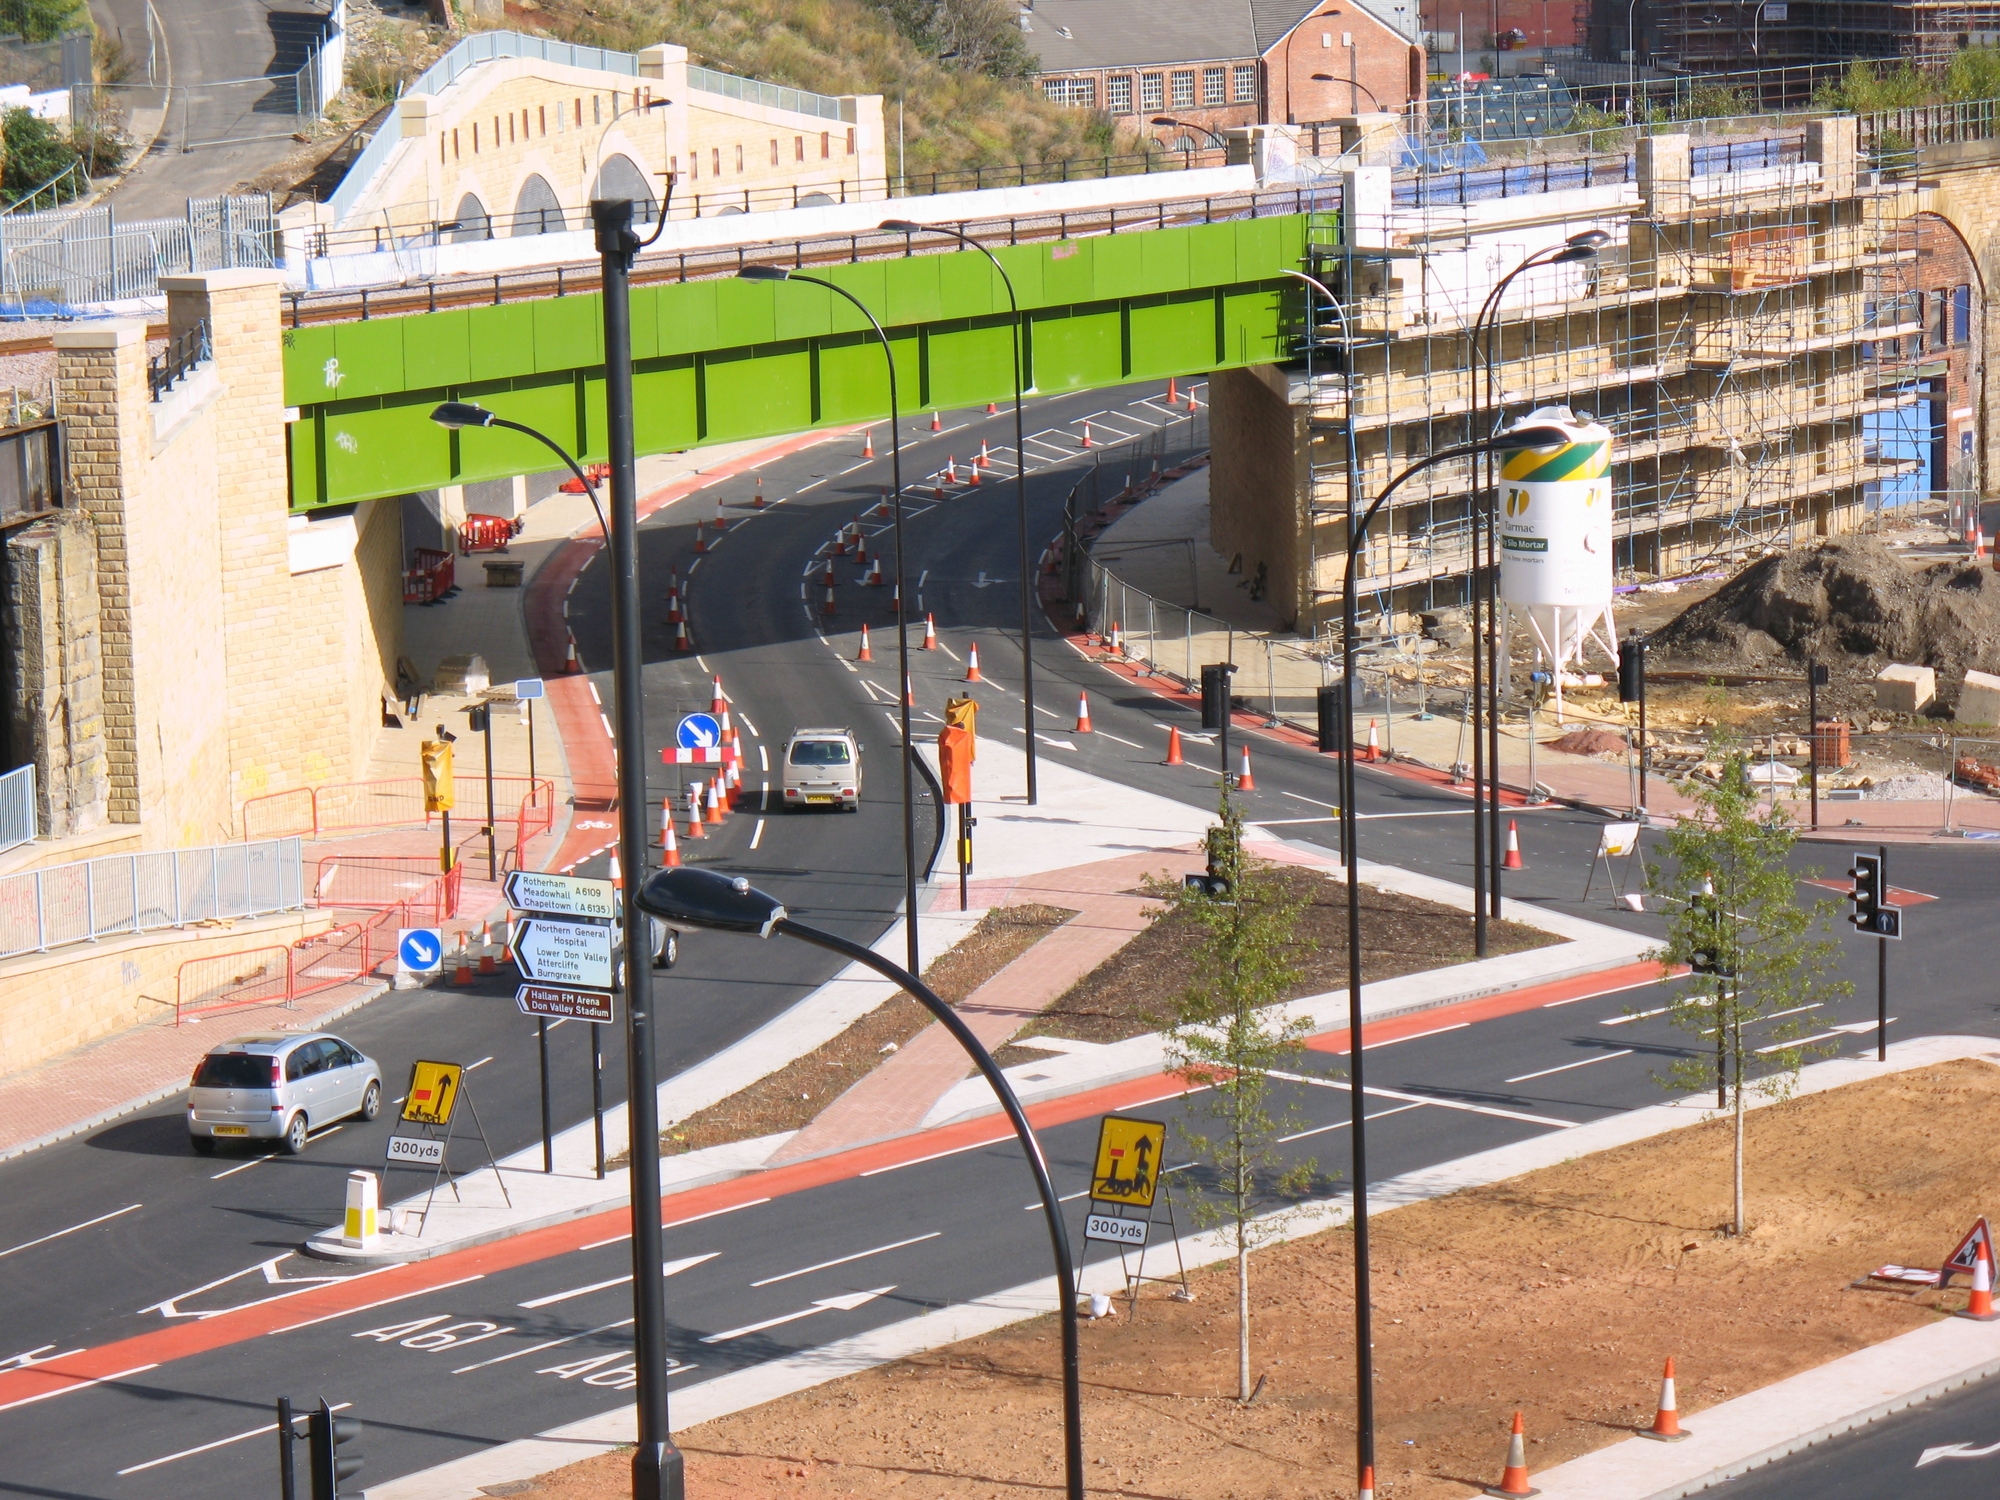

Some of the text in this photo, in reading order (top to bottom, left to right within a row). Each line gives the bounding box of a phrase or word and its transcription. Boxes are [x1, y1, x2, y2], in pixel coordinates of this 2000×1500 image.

[1504, 520, 1535, 533] Tarmac
[1518, 540, 1545, 549] Mortar
[522, 876, 566, 888] Rotherham
[523, 887, 571, 899] Meadowhall
[524, 897, 571, 910] Chapeltown
[535, 923, 606, 939] Northern General
[553, 936, 588, 947] Hospital
[536, 947, 608, 964] Lower Don Valley
[537, 958, 579, 970] Attercliffe
[537, 968, 581, 981] Burngreave
[531, 990, 600, 1006] Hallam FM Arena
[531, 1001, 609, 1018] Don Valley Stadium
[351, 1314, 516, 1353] A61
